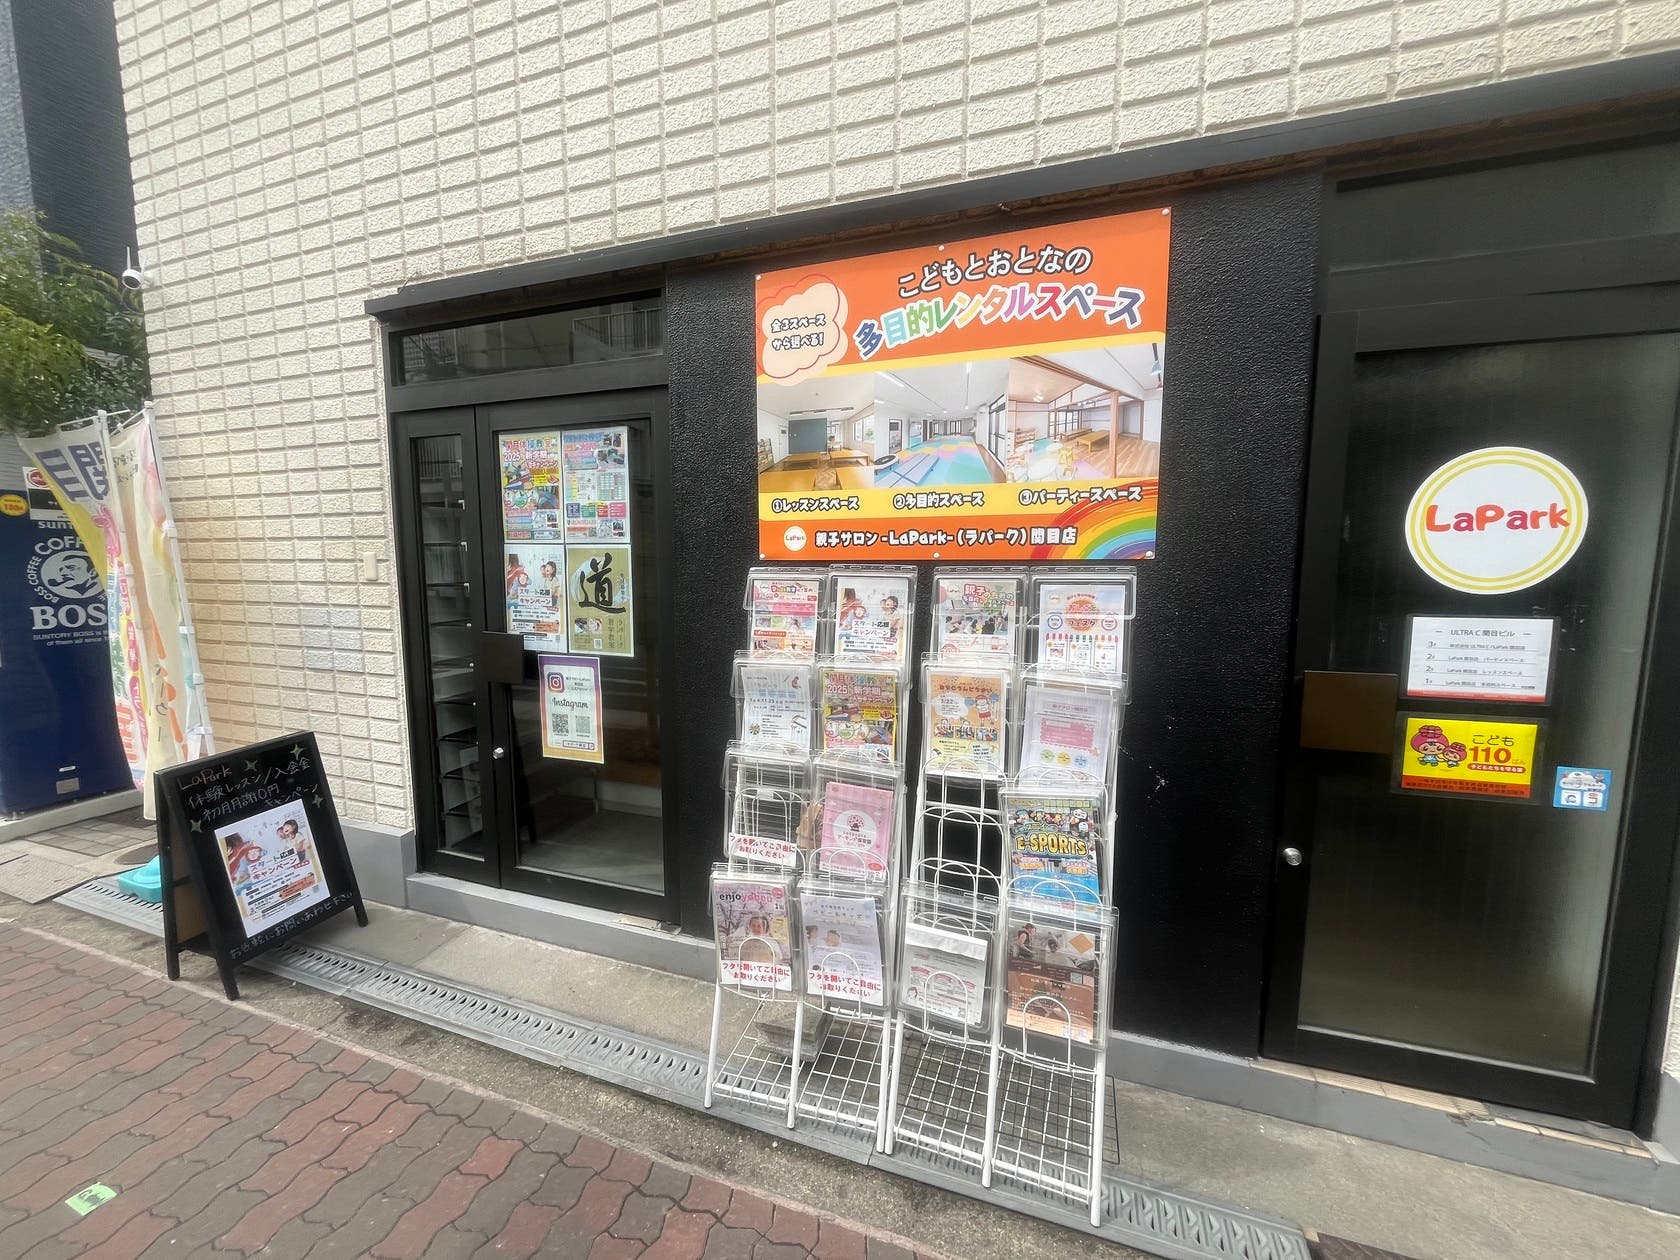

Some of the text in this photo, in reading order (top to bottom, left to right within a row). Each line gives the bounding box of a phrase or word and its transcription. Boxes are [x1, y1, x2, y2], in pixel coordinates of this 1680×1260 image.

[898, 245, 1092, 297] こどもとおとなの
[771, 313, 826, 333] 全3スペース
[854, 284, 1144, 359] 多目的レンタルスペース
[1426, 503, 1571, 532] LaPark
[815, 530, 878, 547] 親子サロン
[1030, 526, 1078, 546] 関目店
[579, 552, 626, 614] 道
[520, 596, 550, 605] キャンペーン
[852, 628, 890, 636] キャンペーン
[1482, 630, 1516, 638] 関目ビル
[828, 684, 848, 694] 2025
[552, 696, 588, 711] Instagram
[1472, 735, 1514, 746] こども
[1468, 746, 1512, 764] 110
[178, 764, 232, 790] LaPark
